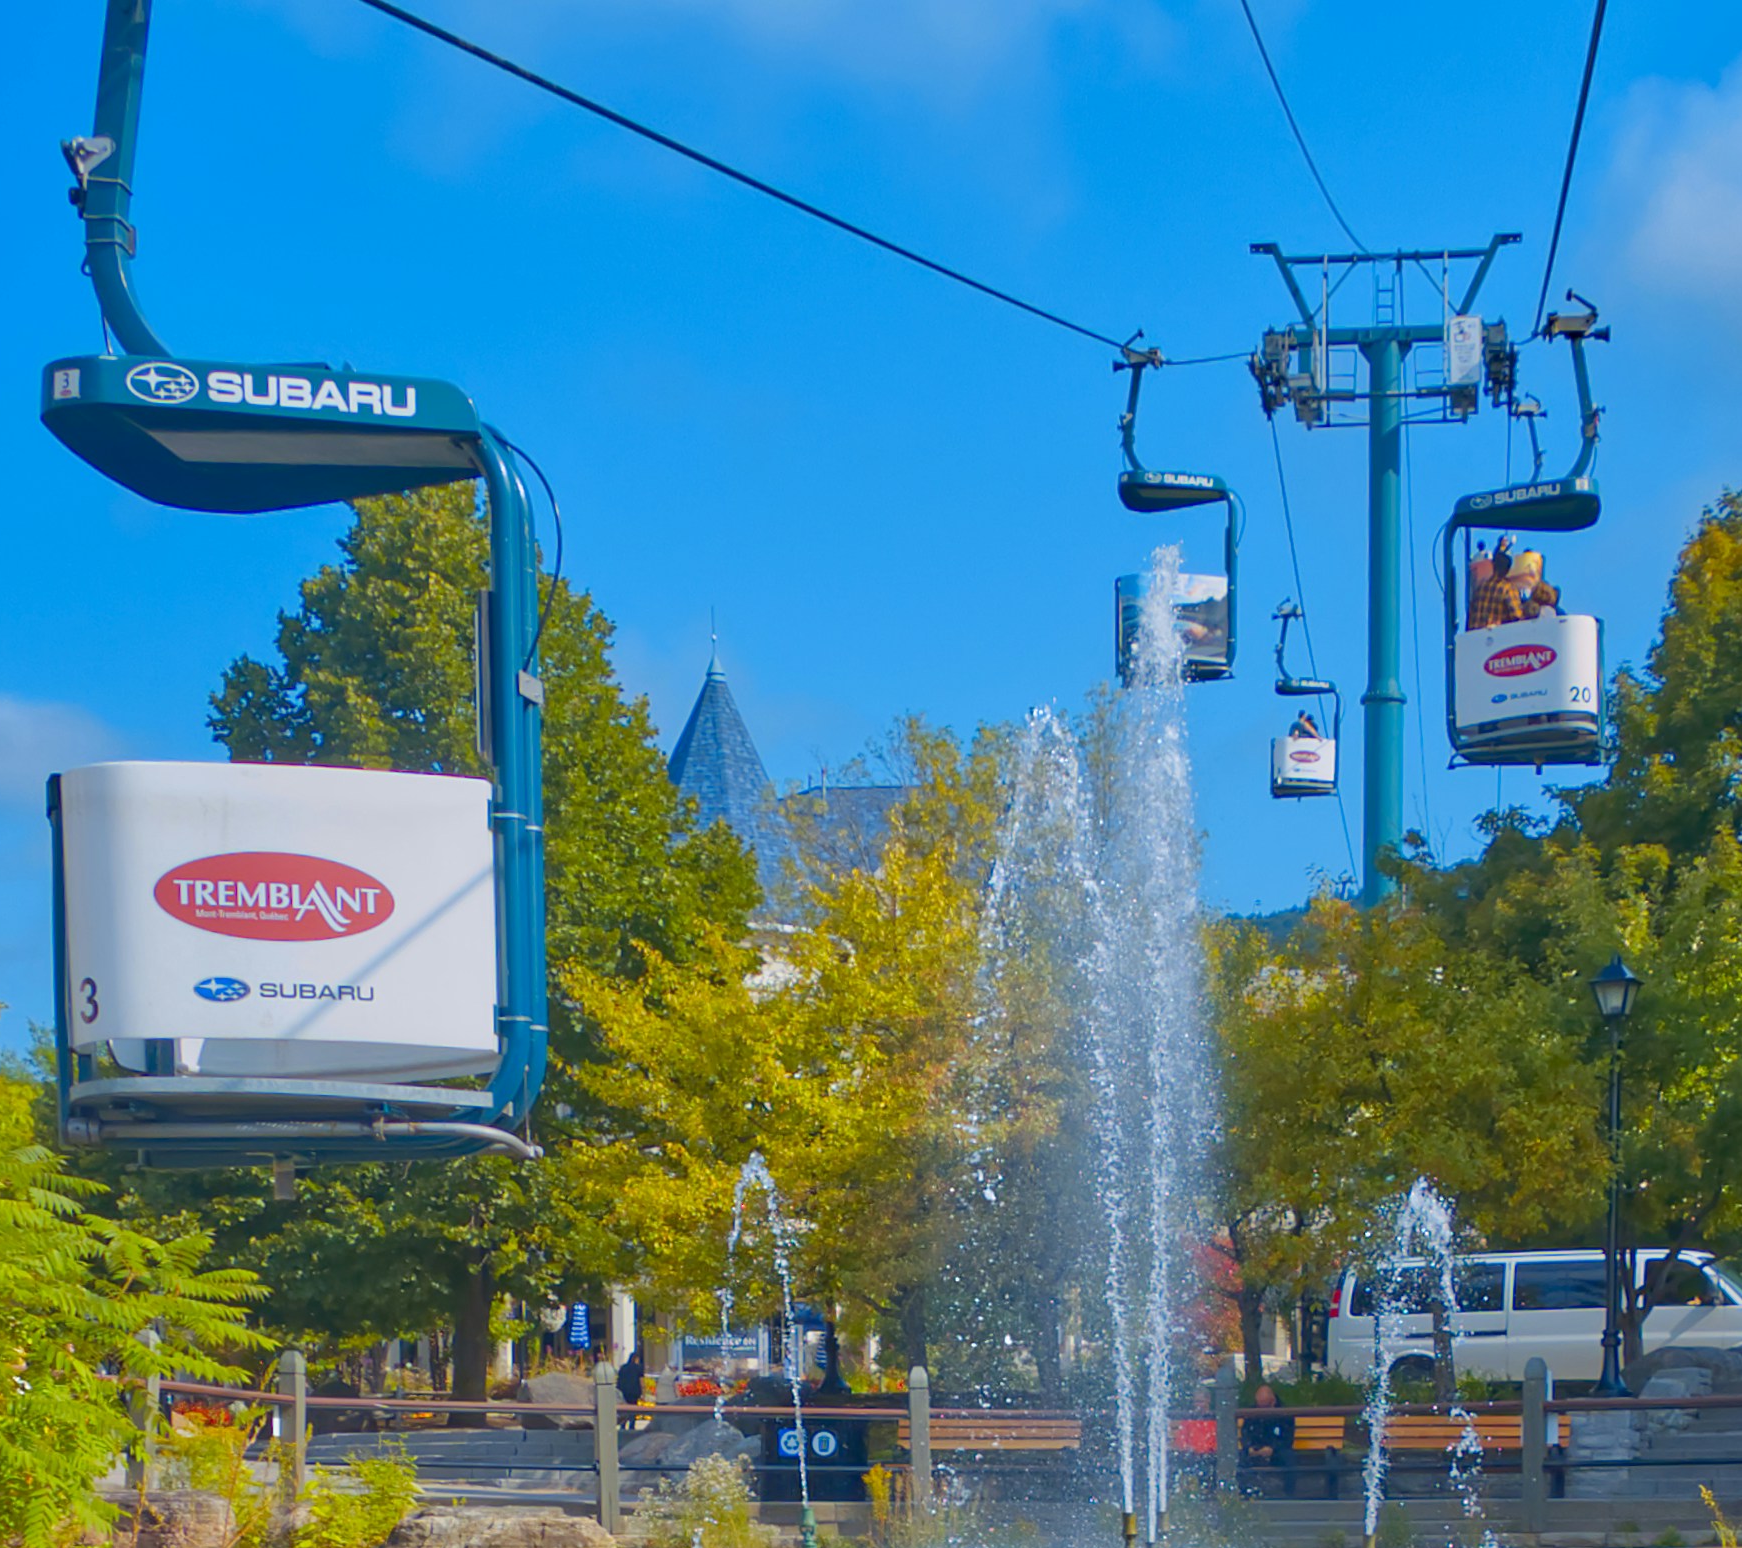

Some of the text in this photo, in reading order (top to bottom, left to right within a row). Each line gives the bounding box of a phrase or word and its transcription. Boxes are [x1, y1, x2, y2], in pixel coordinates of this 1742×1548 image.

[61, 371, 70, 389] 3
[206, 370, 417, 418] SUBARU
[1163, 472, 1214, 488] SUBARU
[1494, 483, 1561, 505] SUBARU
[1488, 651, 1554, 671] TREMBLANT
[1569, 686, 1592, 703] 20
[172, 879, 382, 933] TREMBLANT
[79, 977, 100, 1025] 3
[259, 982, 375, 1002] SUBARU
